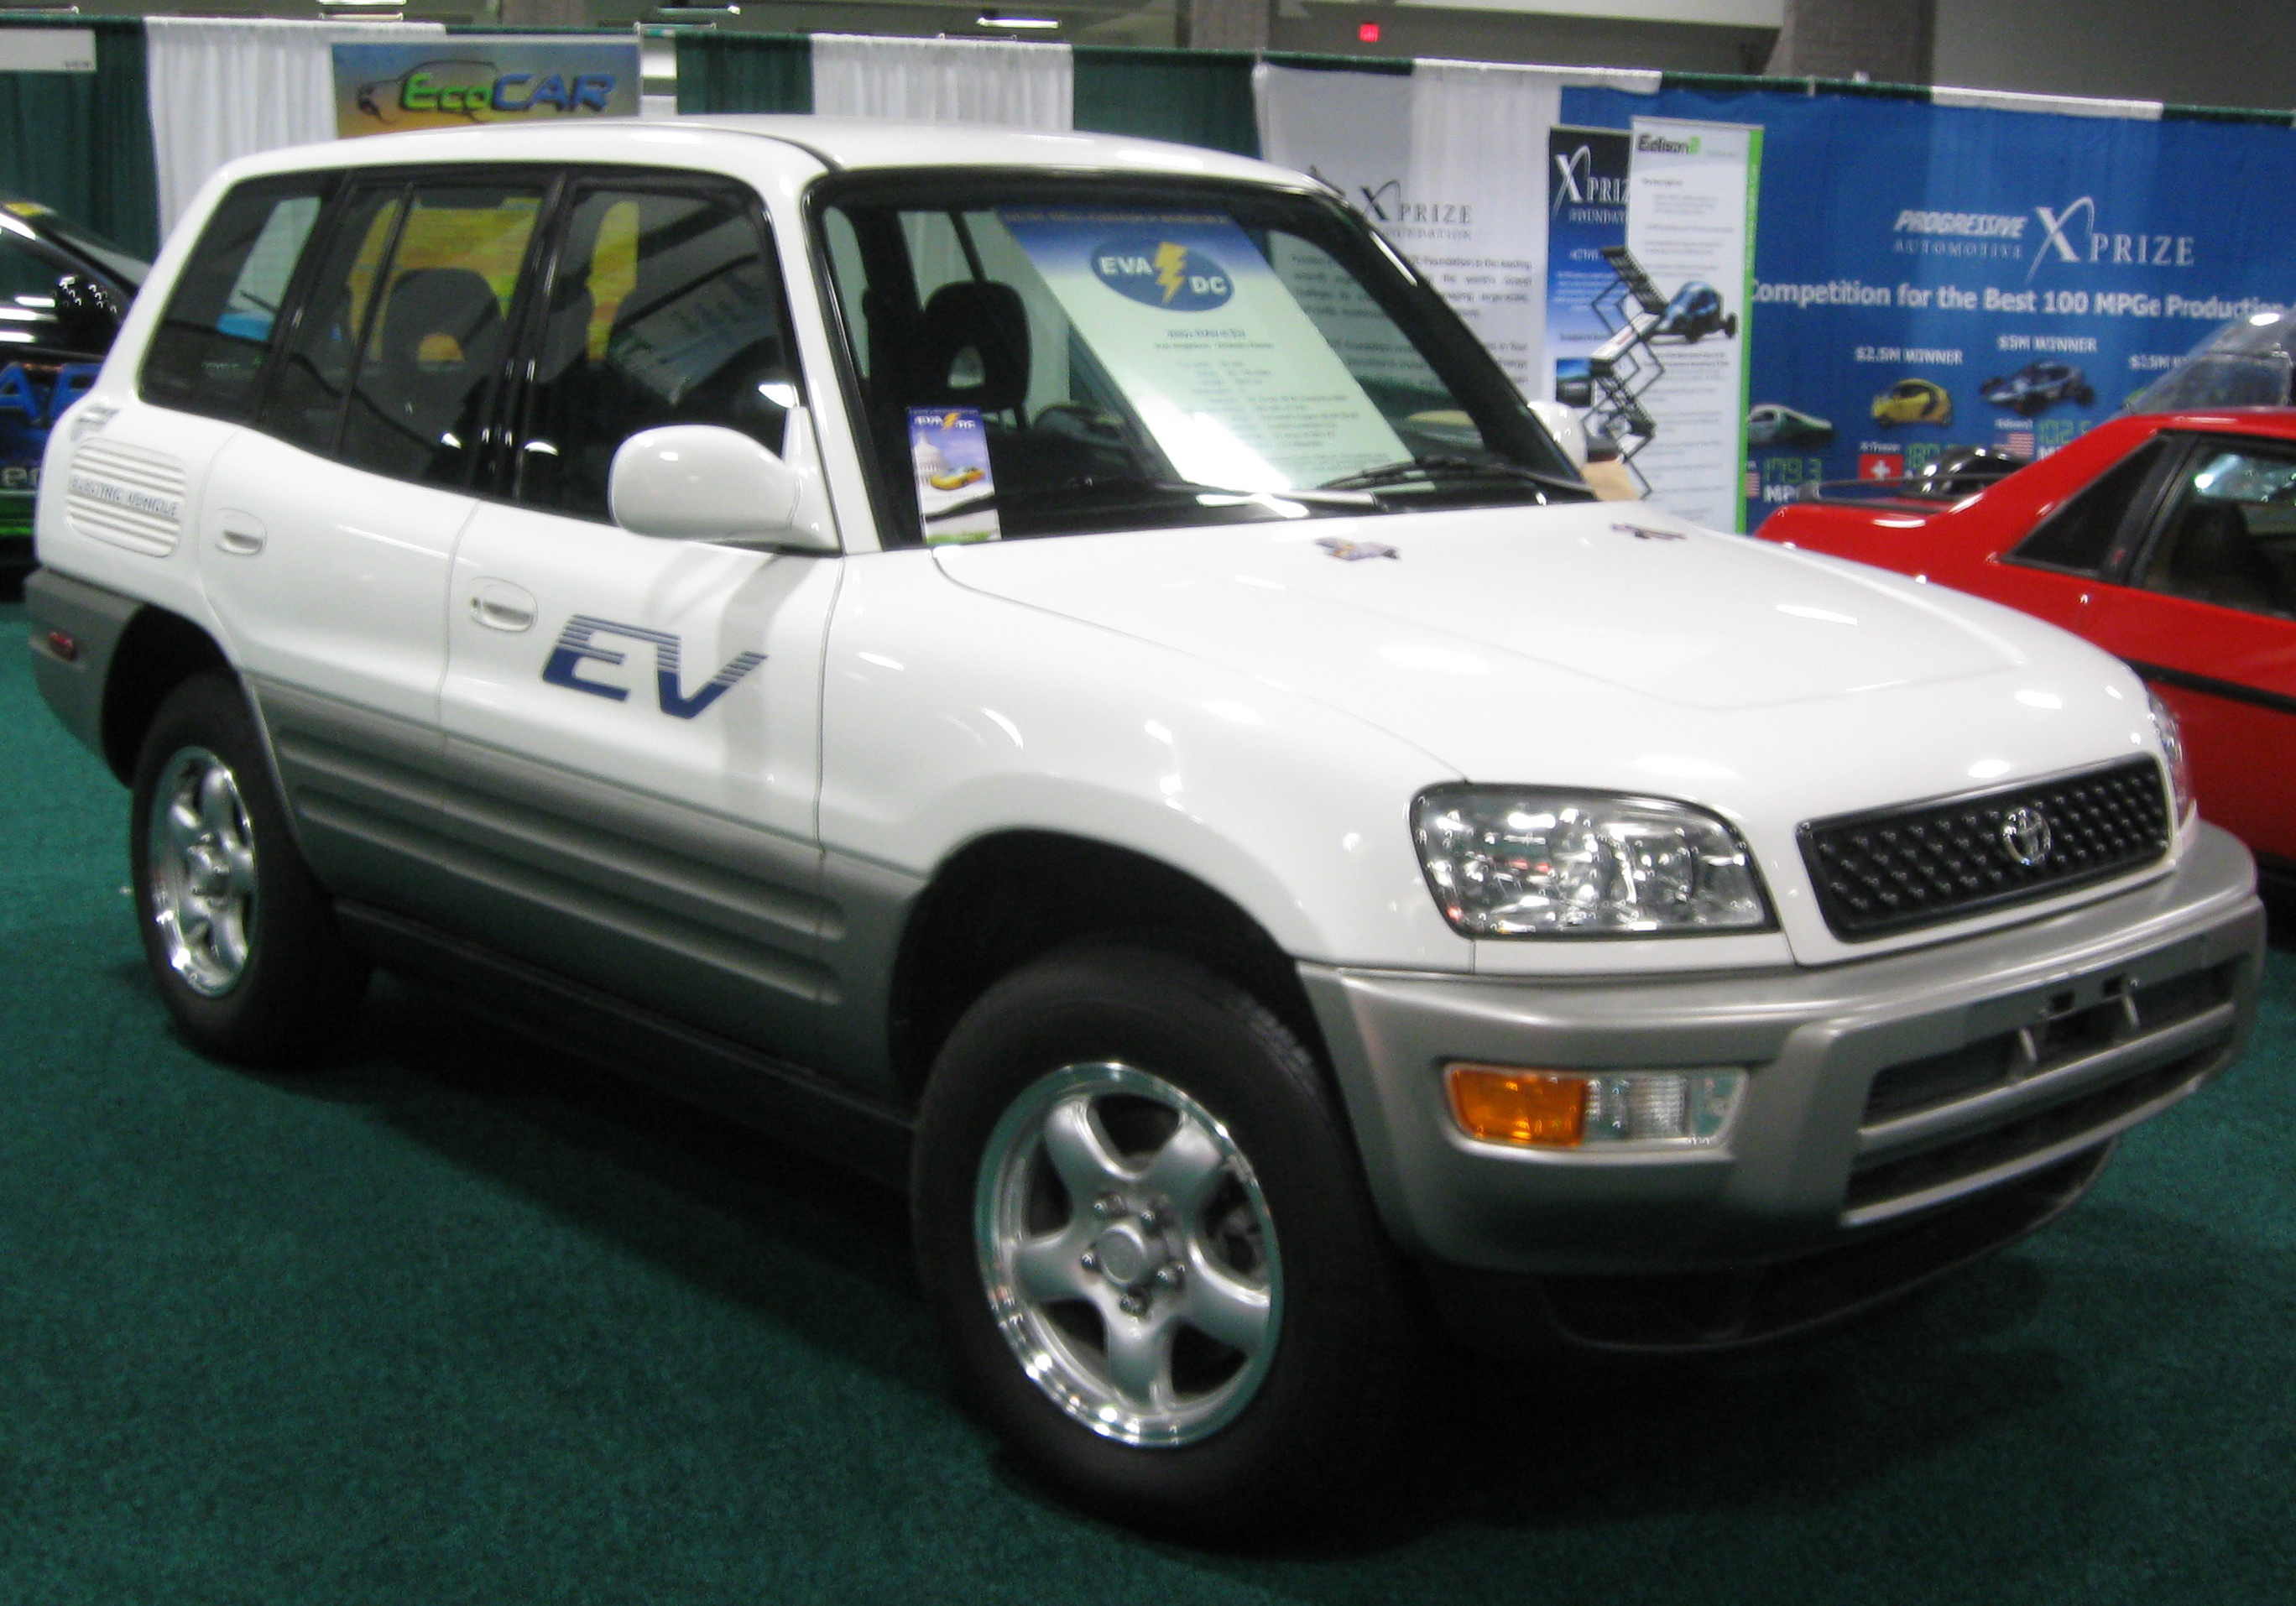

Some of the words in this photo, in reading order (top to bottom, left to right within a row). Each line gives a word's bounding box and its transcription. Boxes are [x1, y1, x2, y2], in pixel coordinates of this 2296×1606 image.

[401, 71, 617, 112] EcoCAR
[1098, 255, 1155, 277] EVA
[1188, 274, 1228, 295] DC
[1752, 279, 1891, 310] ompetition
[1897, 283, 1933, 307] for
[1937, 285, 1978, 310] the
[1983, 288, 2037, 314] Best
[2043, 291, 2090, 315] 100
[2094, 294, 2162, 318] MPGe
[1902, 347, 1964, 365] WINNER
[542, 613, 770, 720] EV
